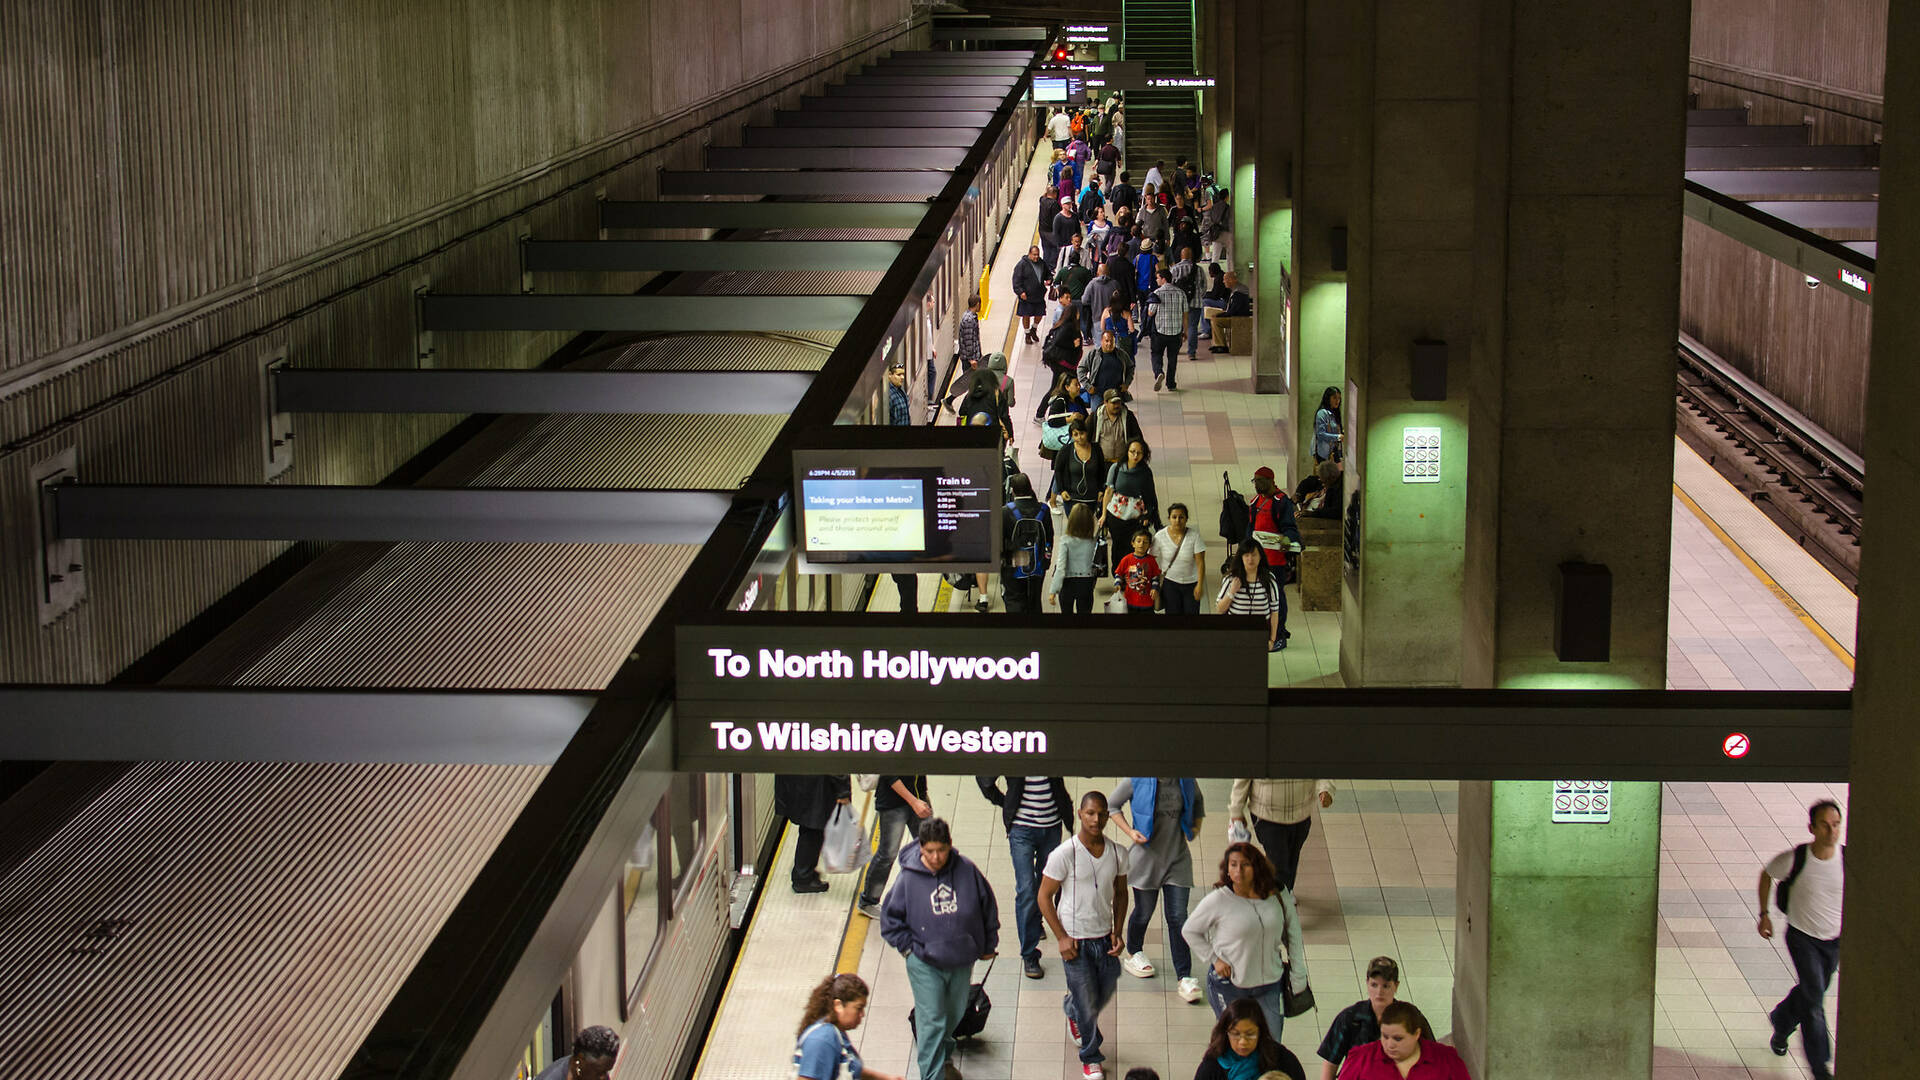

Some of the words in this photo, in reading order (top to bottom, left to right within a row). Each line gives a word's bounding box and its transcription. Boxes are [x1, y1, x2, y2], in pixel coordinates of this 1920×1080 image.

[809, 496, 835, 505] Taking
[707, 649, 750, 678] To
[759, 649, 854, 678] North
[863, 650, 1040, 686] Hollywood
[710, 722, 752, 750] To
[757, 722, 1047, 753] Wilshire/Western
